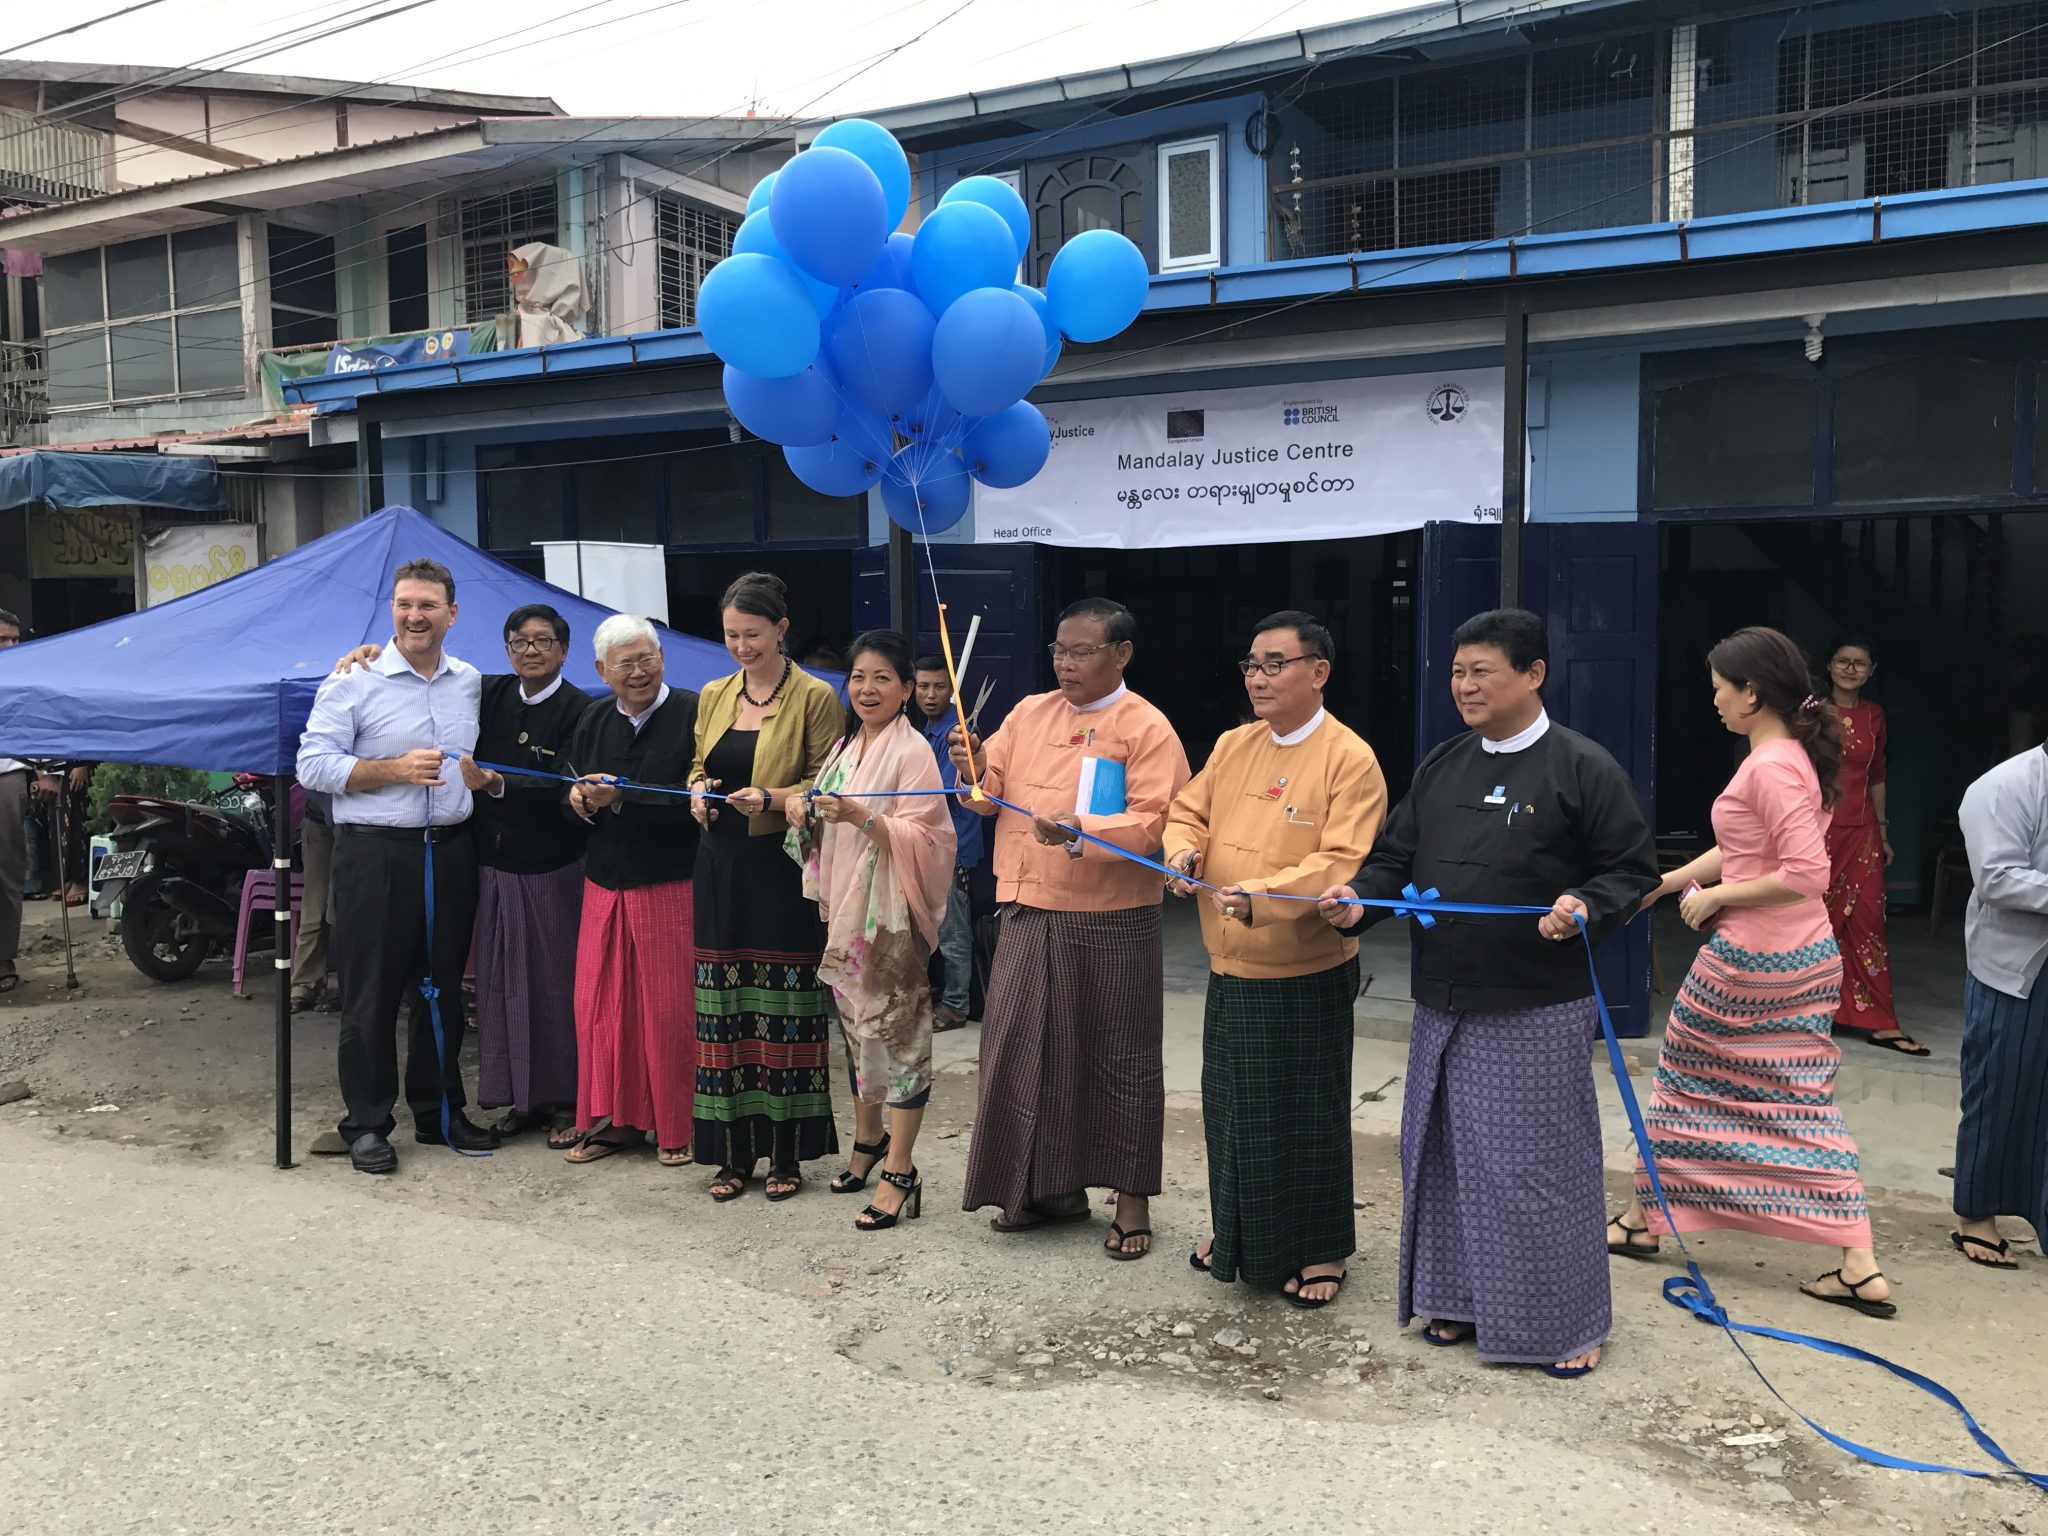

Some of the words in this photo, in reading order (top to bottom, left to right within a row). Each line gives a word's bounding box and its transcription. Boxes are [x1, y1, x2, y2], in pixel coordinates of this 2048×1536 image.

[1302, 405, 1338, 416] BRITISH
[1301, 414, 1340, 425] COUNCIL
[1049, 424, 1095, 442] yJustice
[1117, 450, 1205, 471] Mandalay
[1211, 446, 1279, 466] Justice
[1286, 442, 1354, 461] Centre
[993, 527, 1018, 538] Head
[1021, 526, 1052, 538] Office
